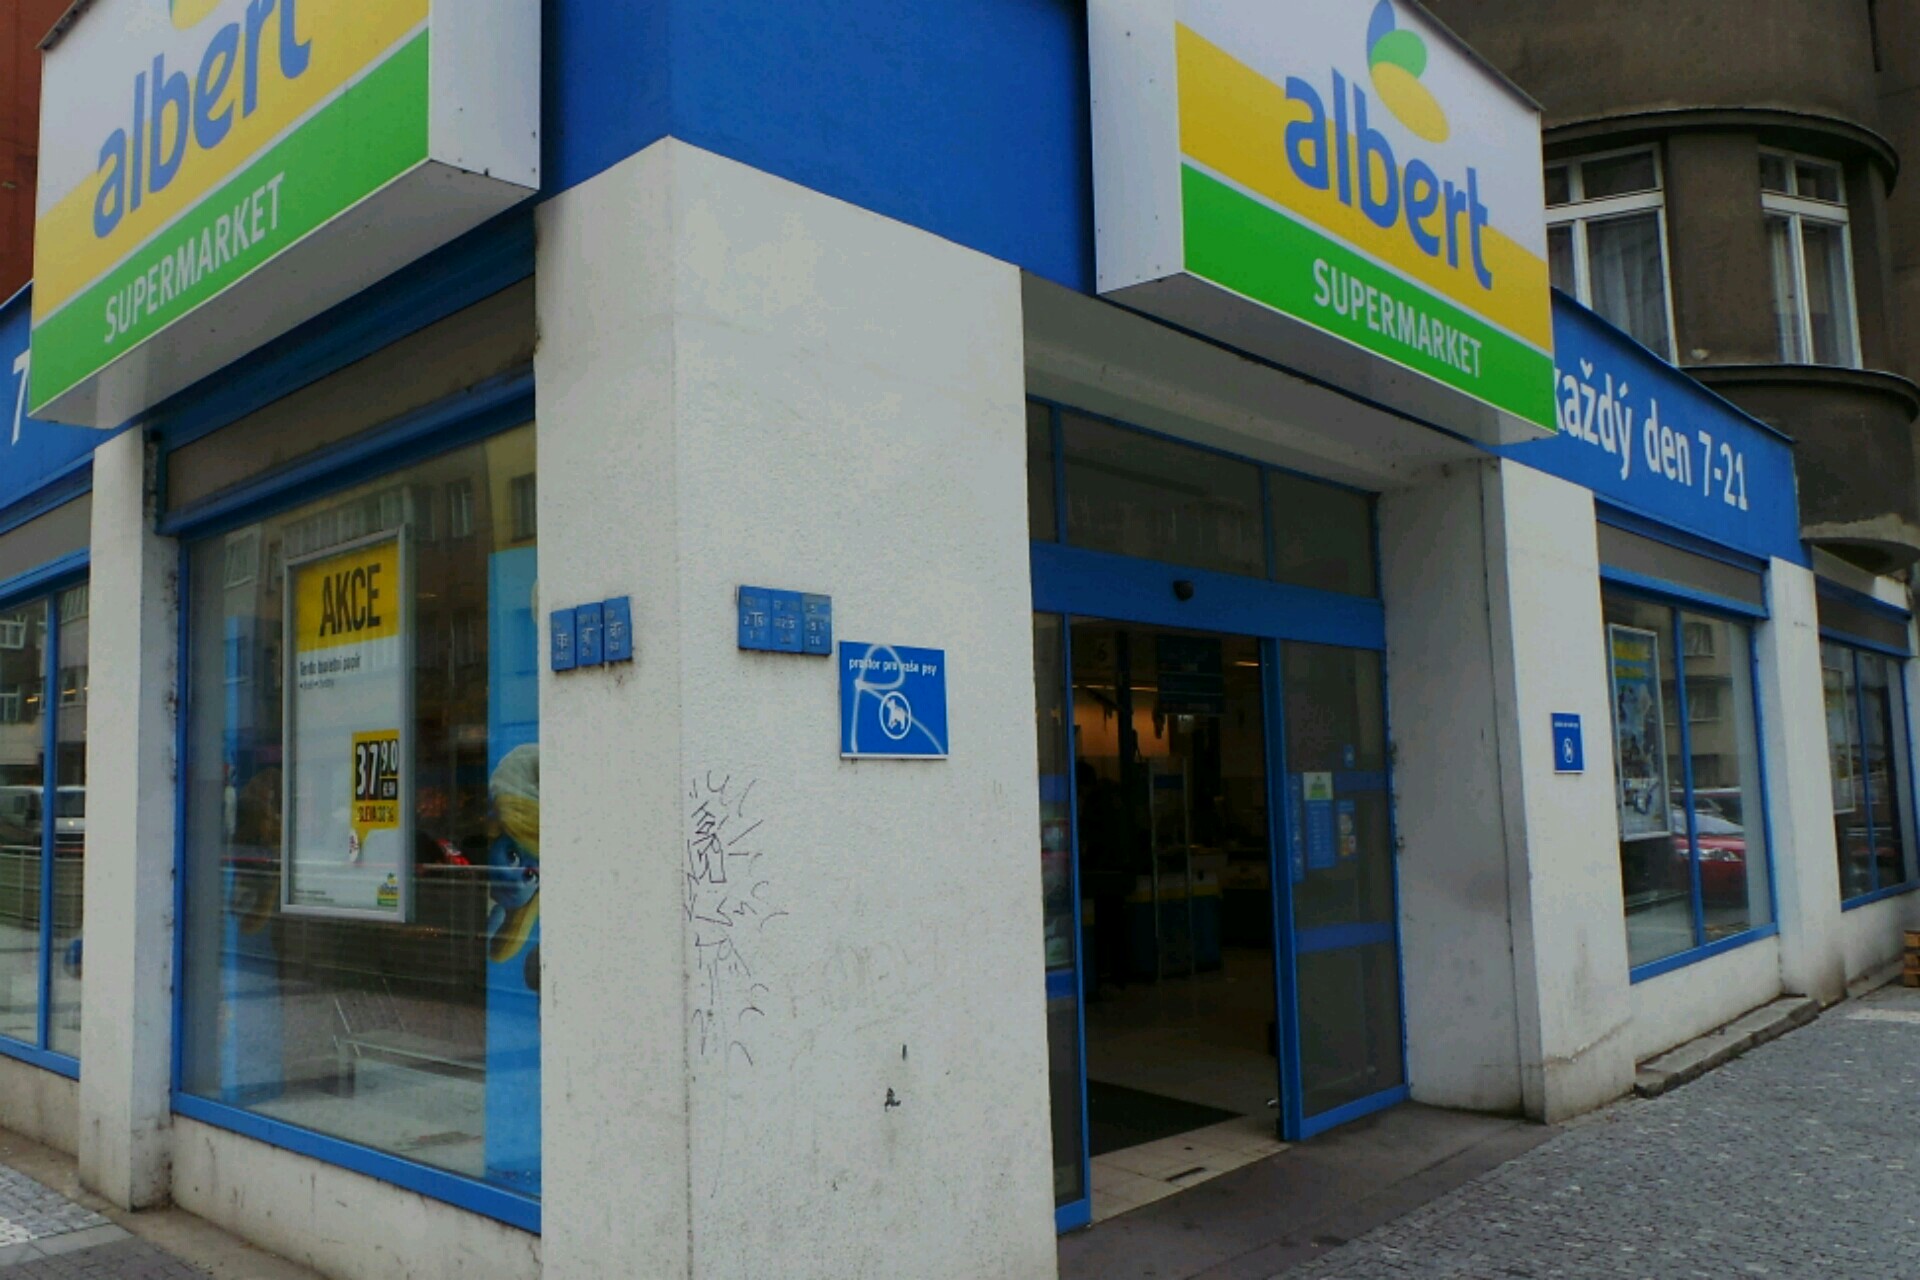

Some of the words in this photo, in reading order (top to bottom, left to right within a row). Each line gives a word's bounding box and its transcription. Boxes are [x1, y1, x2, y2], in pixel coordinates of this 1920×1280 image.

[1284, 67, 1492, 290] albert
[104, 172, 286, 345] SUPERMARKET
[1313, 258, 1482, 378] SUPERMARKET
[1643, 398, 1692, 486] den
[1698, 430, 1749, 512] 7-21
[319, 562, 382, 637] AKCE
[900, 660, 919, 672] aše
[922, 664, 938, 677] psy
[356, 743, 379, 796] 37
[381, 740, 398, 771] 90
